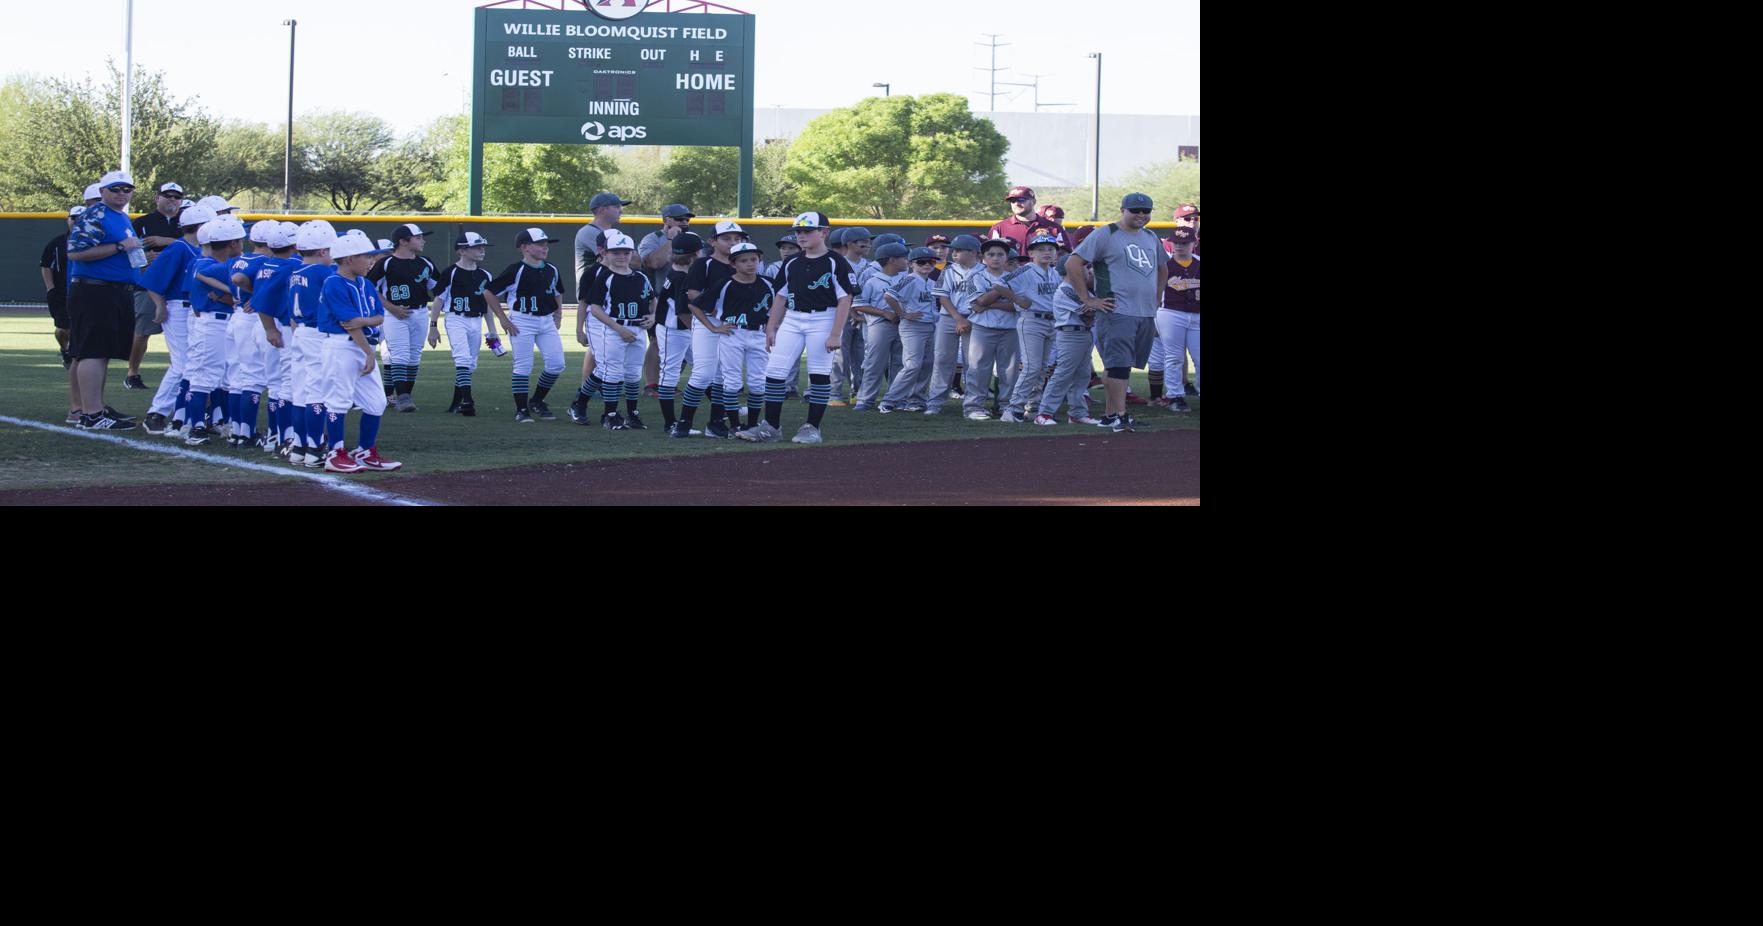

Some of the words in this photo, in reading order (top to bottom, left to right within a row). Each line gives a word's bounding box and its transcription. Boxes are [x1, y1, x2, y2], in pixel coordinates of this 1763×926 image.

[503, 23, 561, 36] WILLIE
[565, 24, 678, 40] BLOOMQUIST
[682, 27, 728, 40] FIELD
[507, 46, 537, 58] BALL
[568, 47, 612, 60] STRIKE
[640, 49, 666, 61] OUT
[689, 50, 700, 62] H
[715, 50, 724, 62] E
[490, 69, 554, 87] GUEST
[675, 73, 736, 91] HOME
[589, 101, 640, 116] INNING
[608, 124, 647, 141] aps
[390, 284, 411, 300] 23
[454, 296, 471, 312] 31
[519, 296, 538, 312] 11
[617, 302, 638, 319] 10
